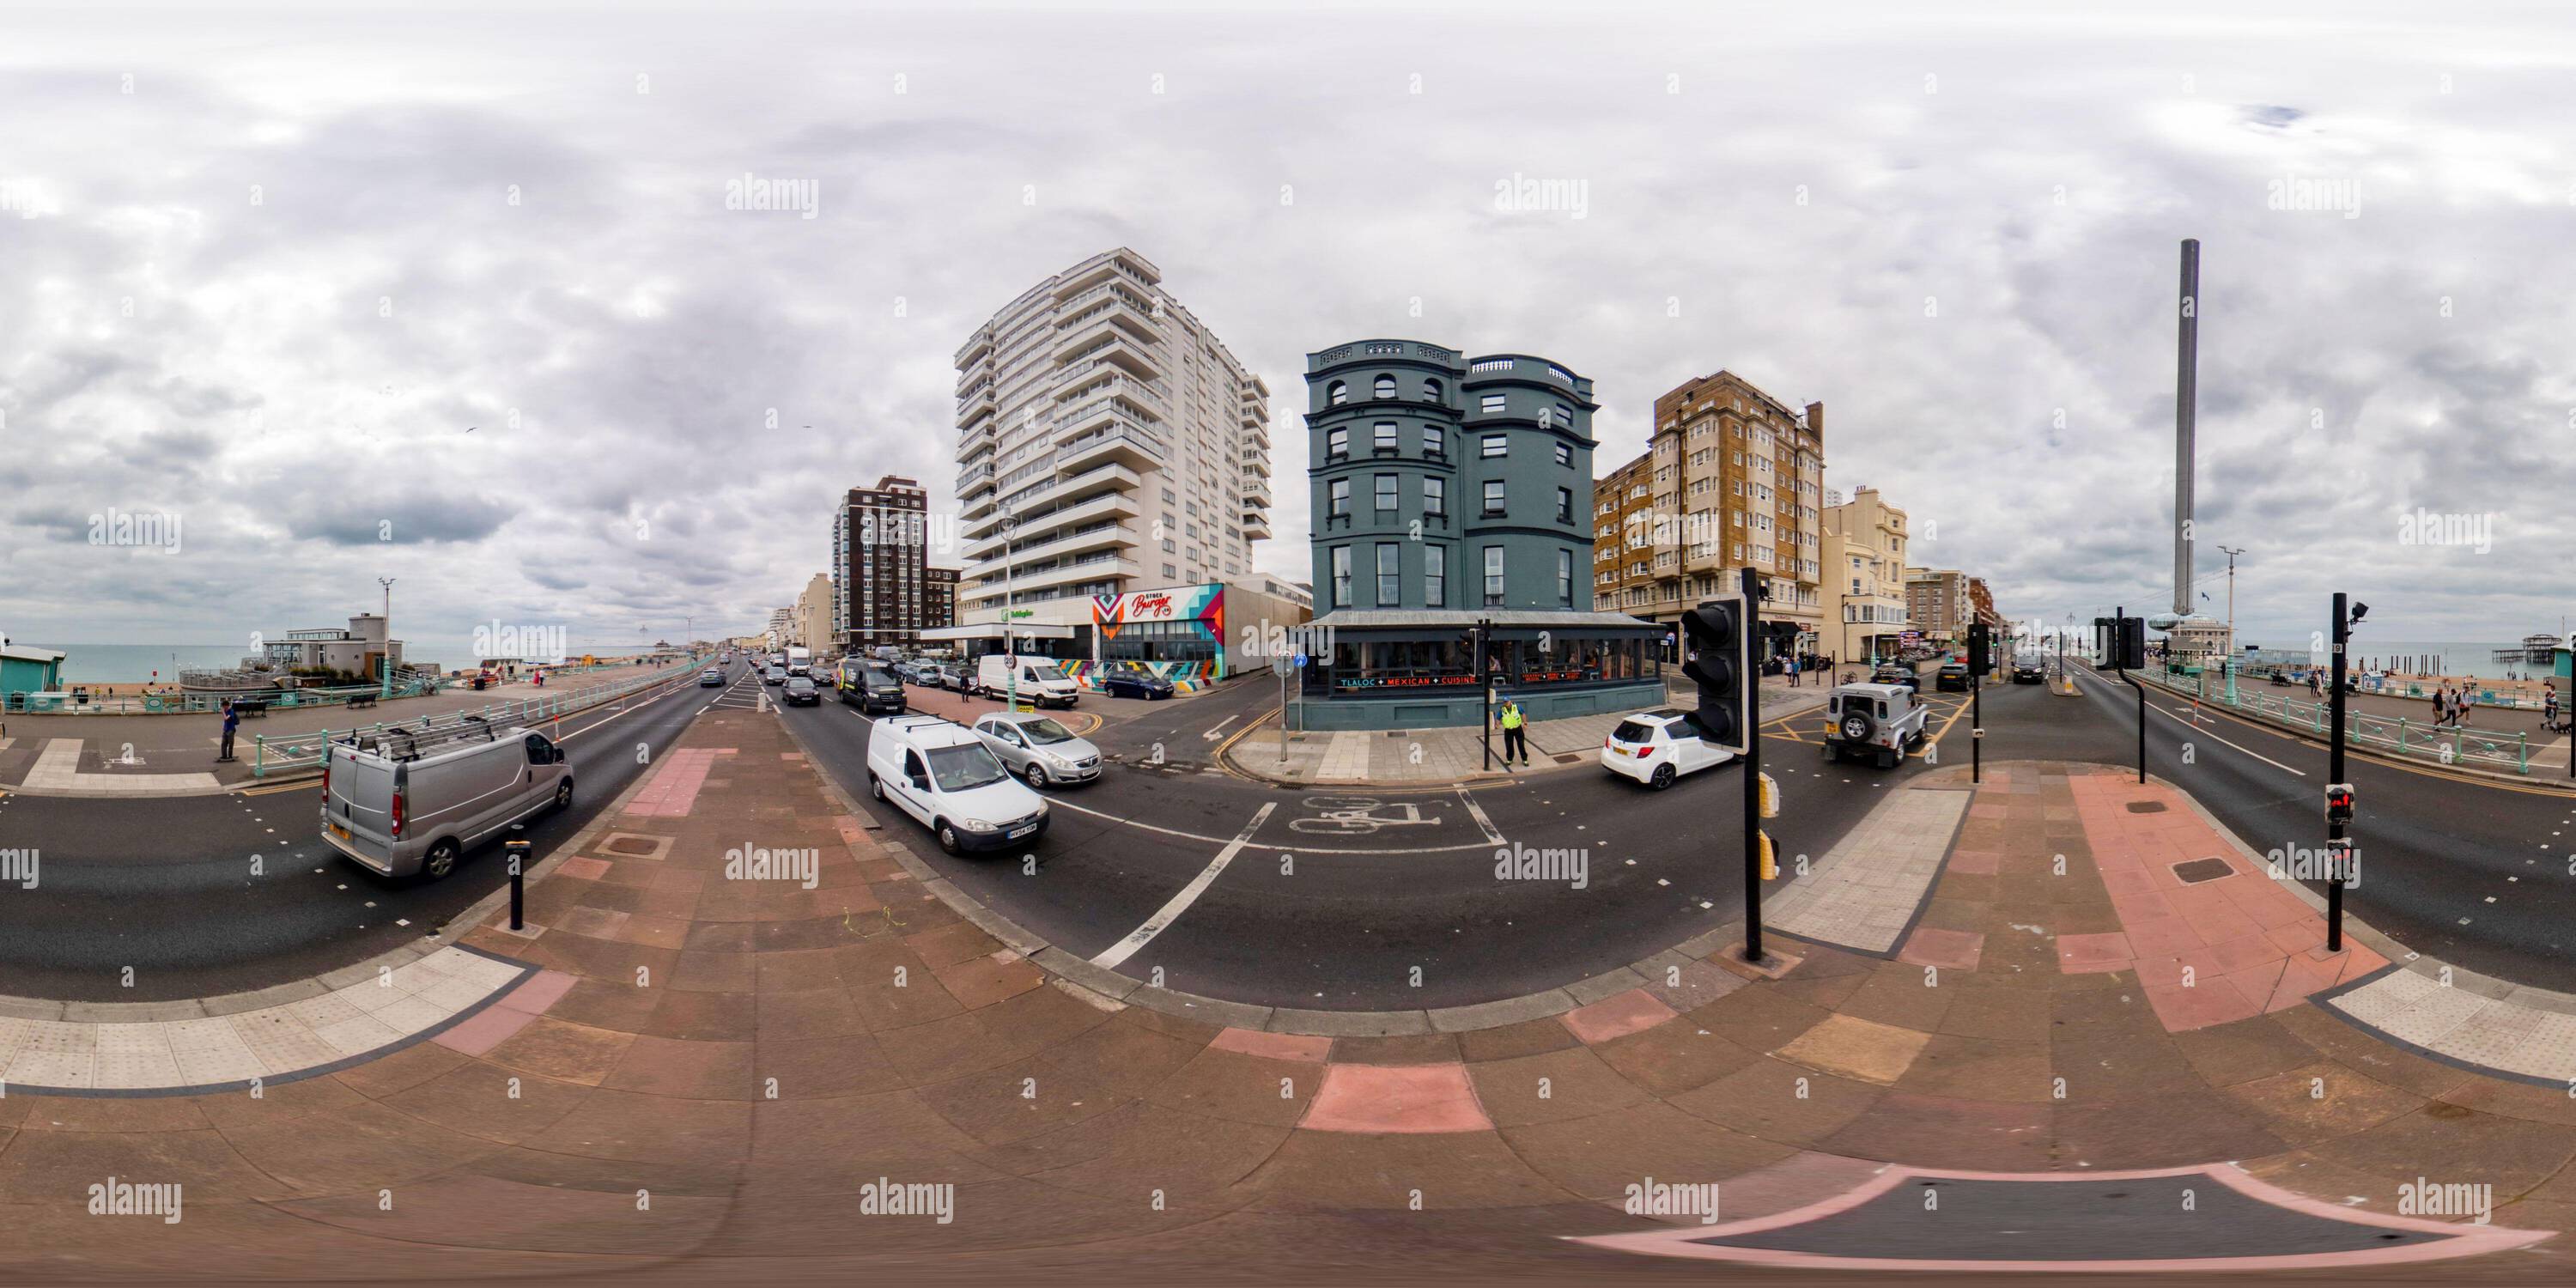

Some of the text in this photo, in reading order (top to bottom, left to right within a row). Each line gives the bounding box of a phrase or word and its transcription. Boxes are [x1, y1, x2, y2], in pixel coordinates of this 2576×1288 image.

[1132, 594, 1172, 617] Burger
[1340, 676, 1476, 687] TLALOC MEXICAN CUISINE
